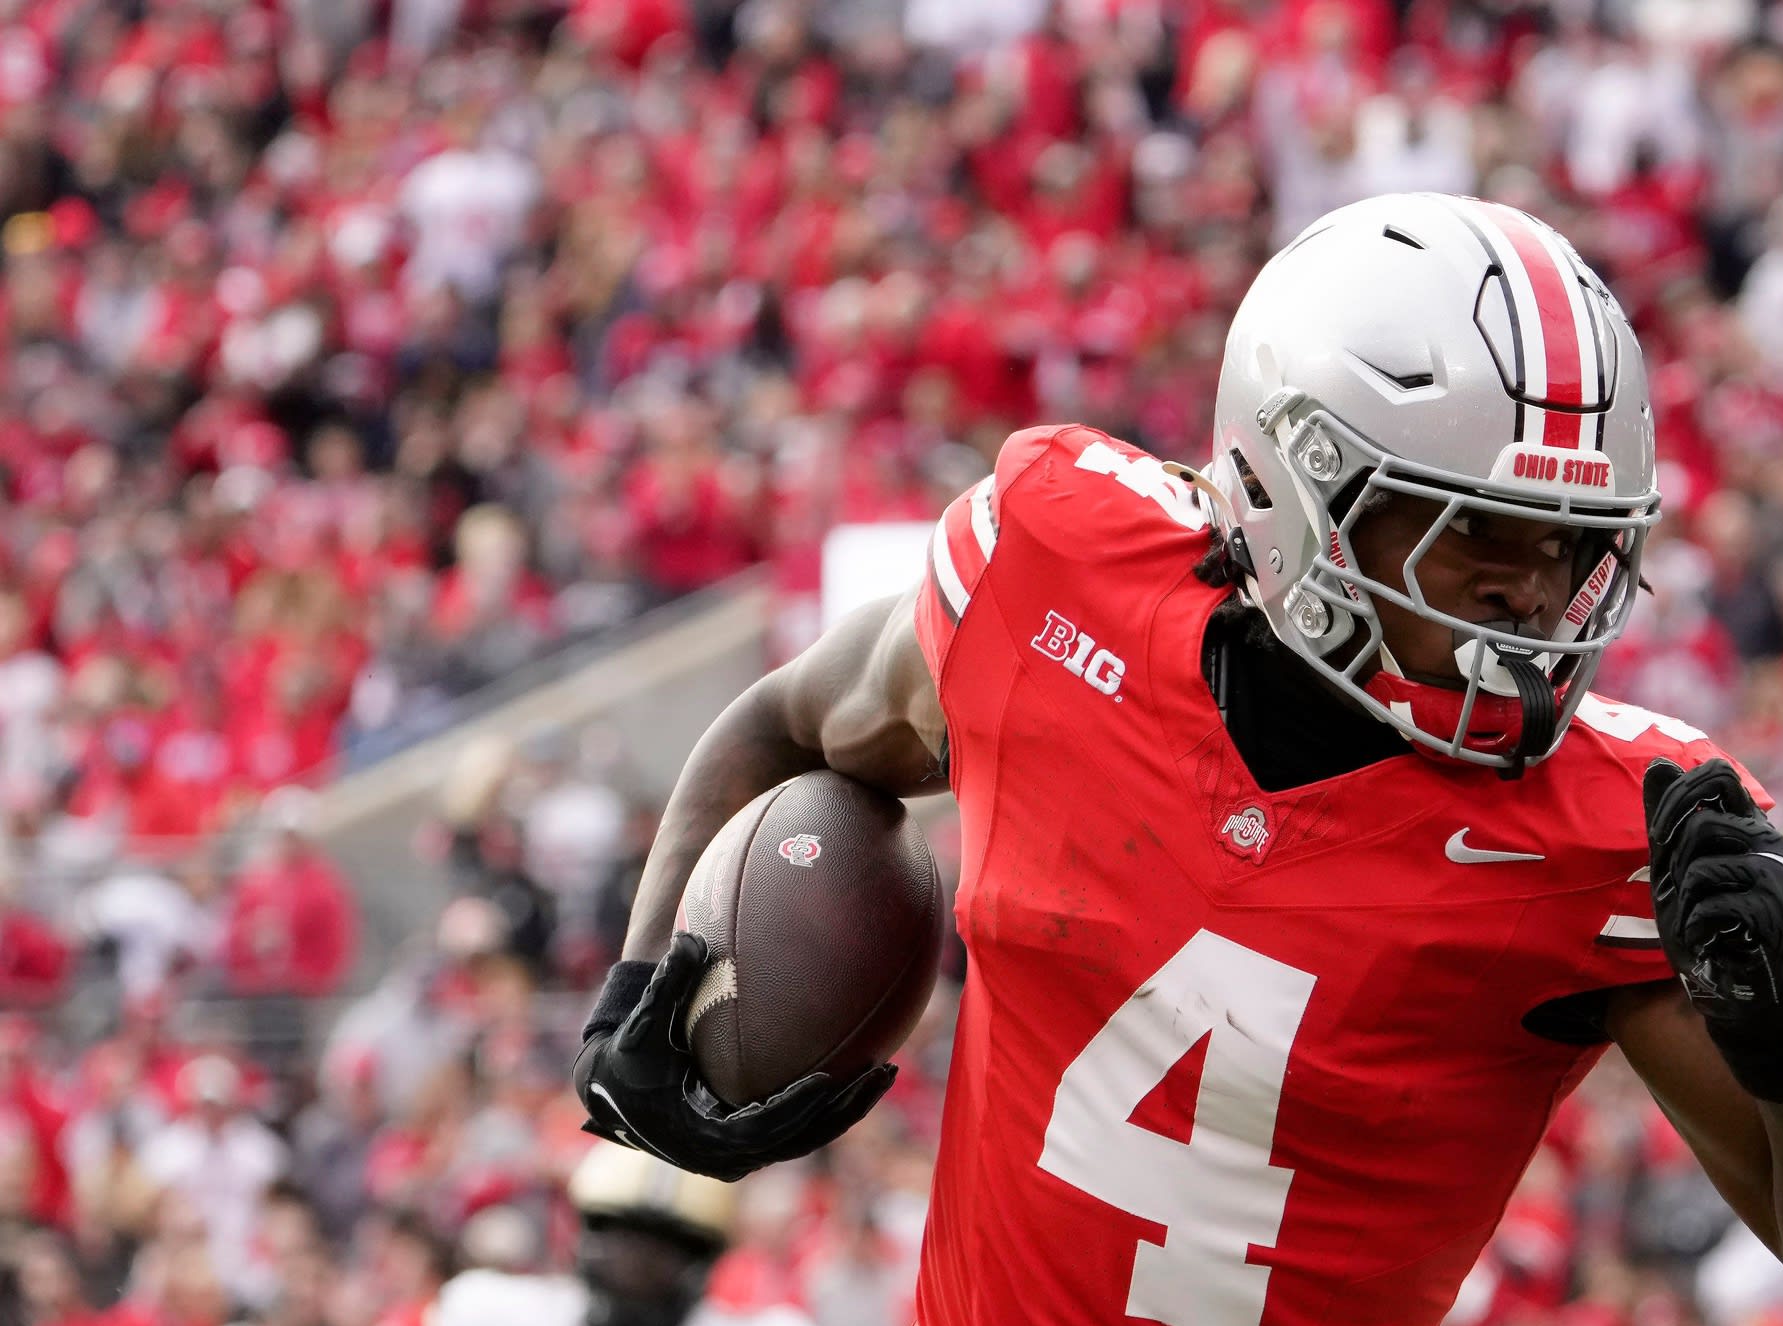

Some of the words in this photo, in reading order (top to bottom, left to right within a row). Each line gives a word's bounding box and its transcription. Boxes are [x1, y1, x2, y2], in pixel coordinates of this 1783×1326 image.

[1513, 452, 1558, 481] OHIO
[1562, 458, 1610, 488] STATE
[1565, 590, 1595, 626] OHIO
[1221, 814, 1250, 834] OHIO
[1242, 817, 1270, 853] STATE
